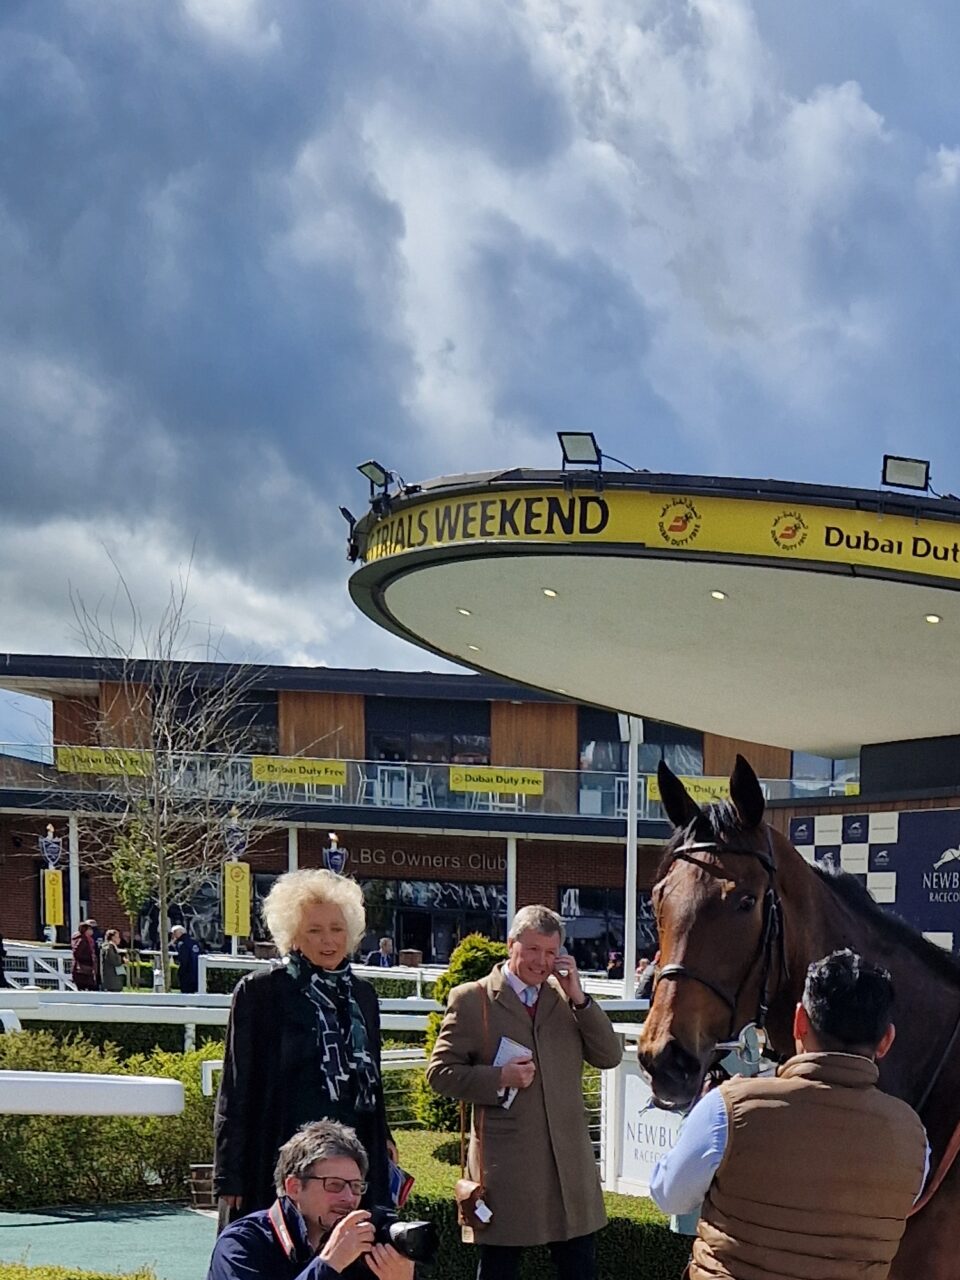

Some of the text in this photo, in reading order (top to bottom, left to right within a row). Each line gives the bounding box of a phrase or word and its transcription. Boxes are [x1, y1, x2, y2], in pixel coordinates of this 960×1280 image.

[375, 510, 428, 557] TRIALS
[435, 496, 609, 542] WEEKEND
[824, 526, 903, 555] Dubai
[299, 766, 322, 777] Duty
[324, 767, 345, 776] Free
[465, 774, 542, 786] Dubai Duty Free
[346, 849, 386, 864] LBG
[391, 850, 460, 868] Owners
[468, 853, 507, 871] Club
